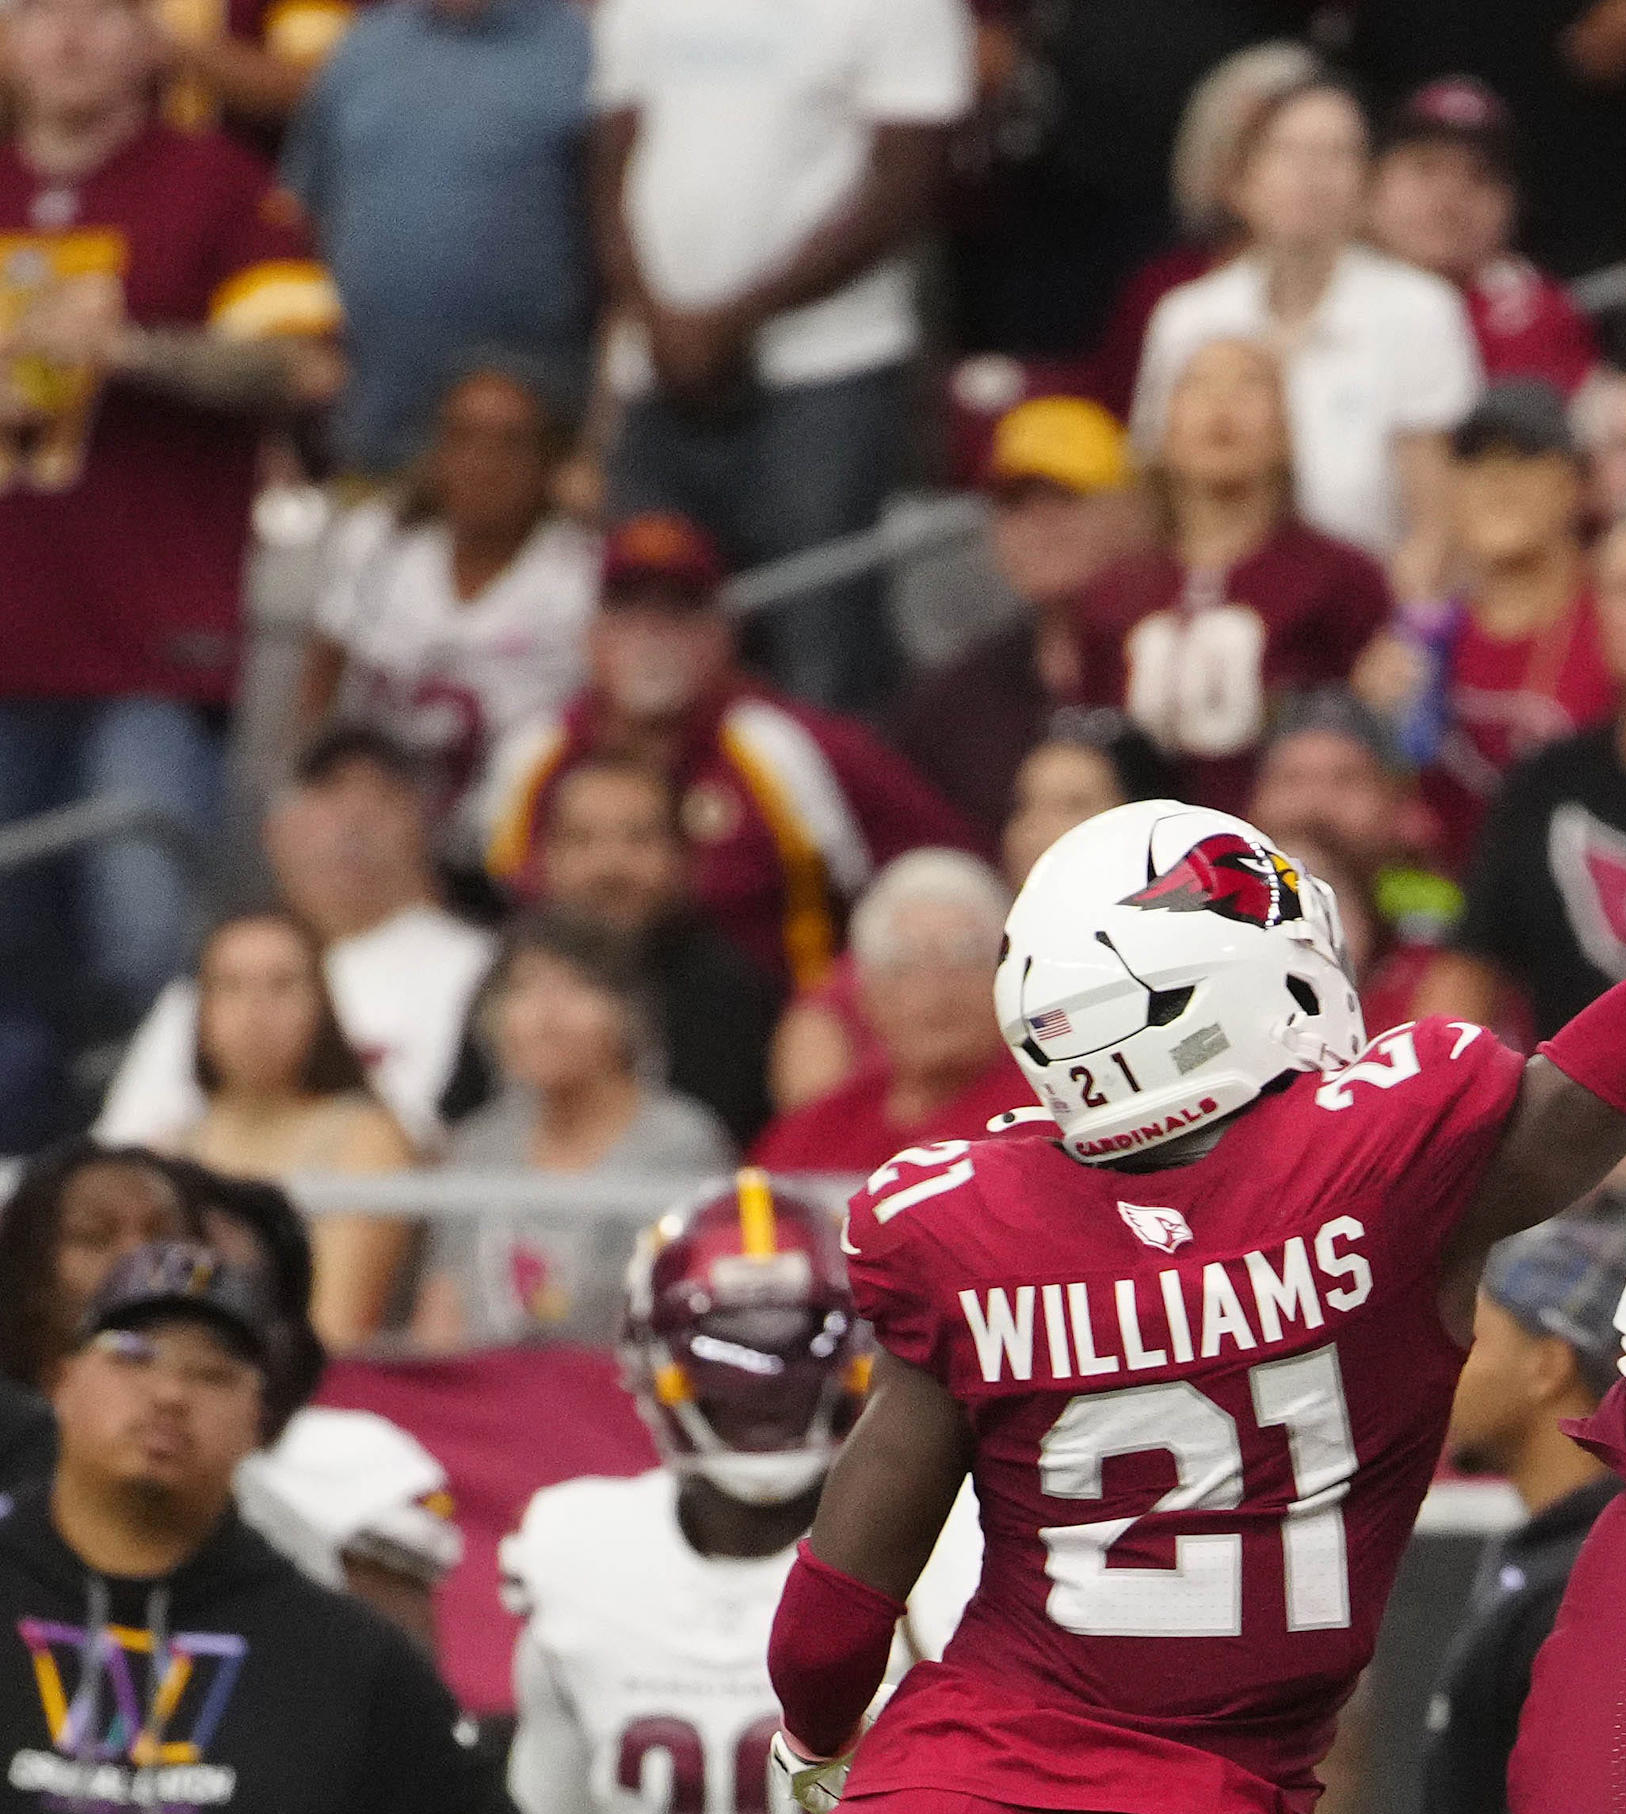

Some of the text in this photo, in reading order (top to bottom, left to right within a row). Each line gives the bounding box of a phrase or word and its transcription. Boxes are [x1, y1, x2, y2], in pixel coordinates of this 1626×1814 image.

[1069, 1051, 1142, 1108] 21
[1075, 1096, 1219, 1156] CARDINALS
[957, 1214, 1374, 1383] WILLIAMS
[1038, 1342, 1360, 1638] 21
